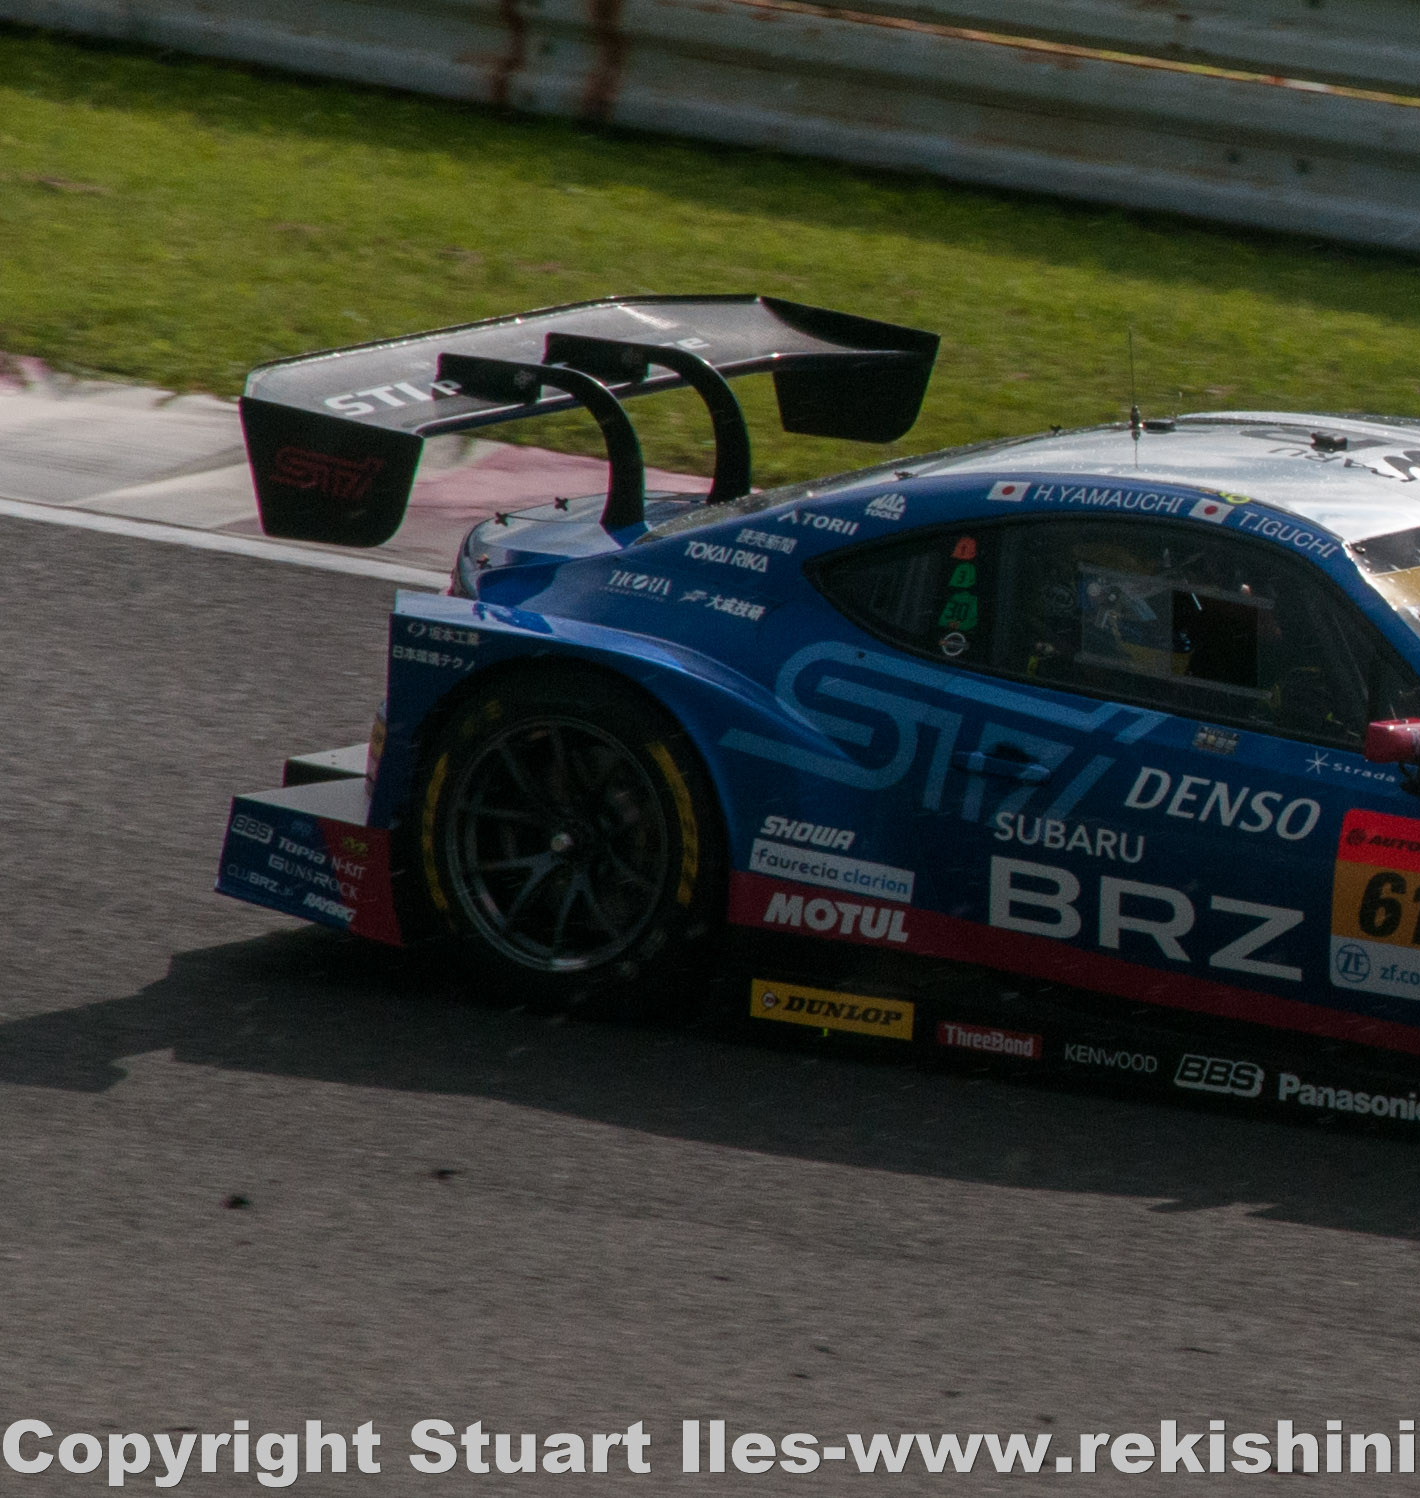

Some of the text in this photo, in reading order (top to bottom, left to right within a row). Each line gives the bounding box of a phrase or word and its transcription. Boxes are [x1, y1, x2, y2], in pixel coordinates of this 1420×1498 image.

[1033, 485, 1184, 514] H.YAMAUCHI
[803, 513, 860, 536] TORII
[1239, 511, 1339, 558] T.IGUCHI
[684, 540, 770, 574] TOKAI RIKA
[1332, 761, 1397, 784] Strada
[1124, 766, 1322, 841] DENSO
[231, 813, 274, 845] BBS
[760, 815, 856, 850] SHOWA
[993, 812, 1146, 864] SUBARU
[756, 848, 910, 895] faurecia clarion
[763, 892, 909, 943] MOTUL
[988, 854, 1305, 983] BRZ
[783, 995, 903, 1027] DUNLOP
[944, 1024, 1035, 1058] ThreeBond
[1064, 1043, 1158, 1073] KENWOOD
[1173, 1053, 1266, 1099] BBS
